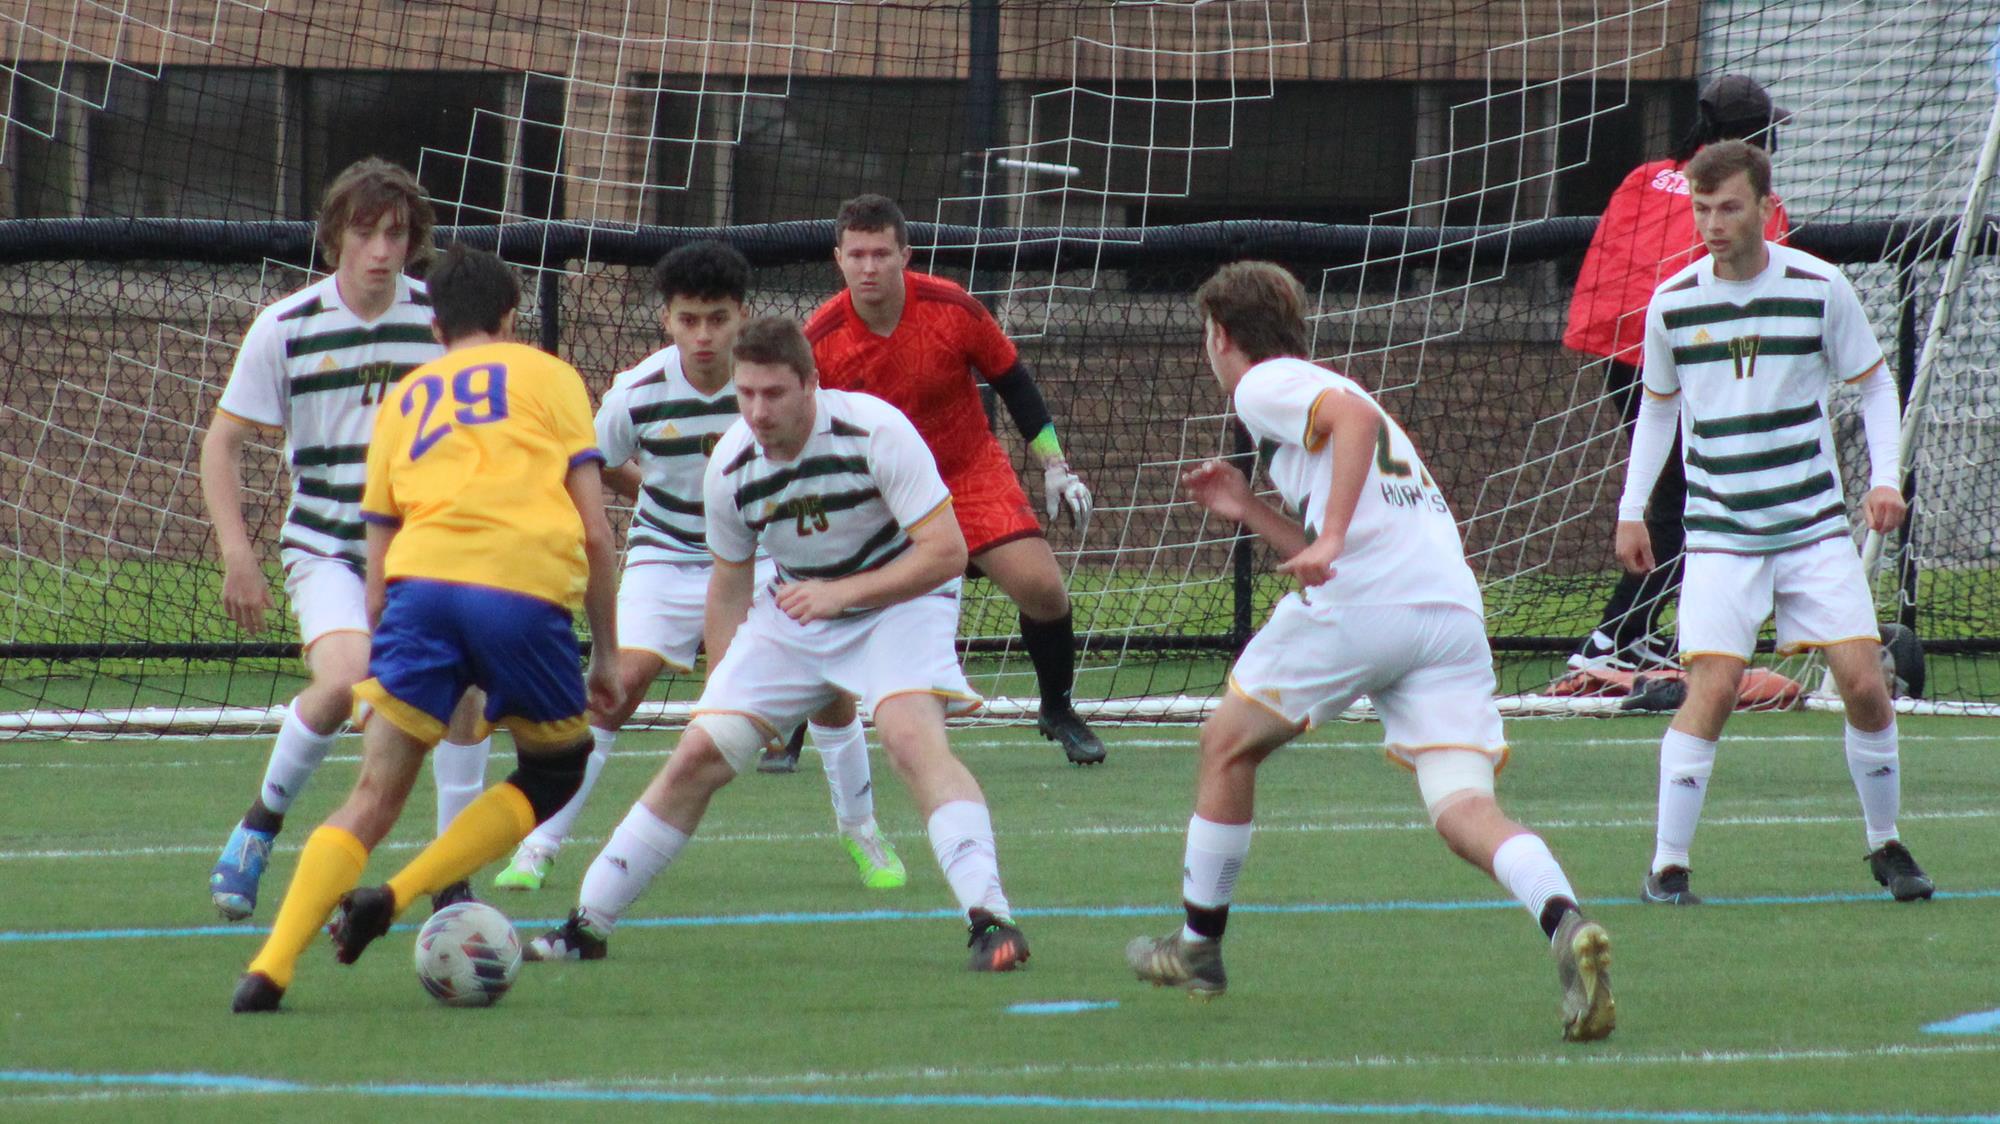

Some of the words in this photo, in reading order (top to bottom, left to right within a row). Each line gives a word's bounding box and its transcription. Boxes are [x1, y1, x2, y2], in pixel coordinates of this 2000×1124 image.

[1728, 334, 1760, 379] 17
[359, 361, 393, 406] 27
[400, 363, 509, 461] 29
[788, 495, 829, 537] 25
